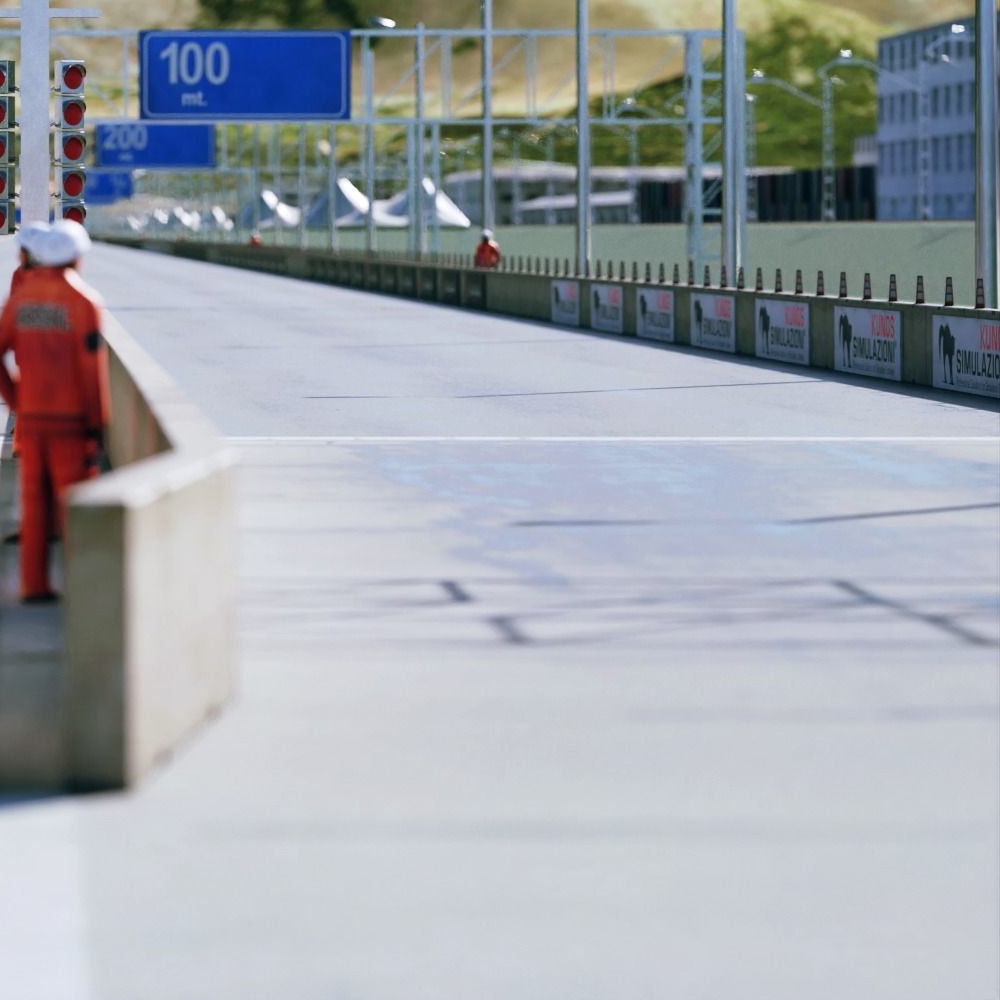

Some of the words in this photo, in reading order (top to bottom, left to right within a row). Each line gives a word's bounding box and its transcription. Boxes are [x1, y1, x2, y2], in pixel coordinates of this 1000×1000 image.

[160, 41, 230, 85] 100
[181, 91, 207, 106] mt.
[103, 124, 148, 150] 200
